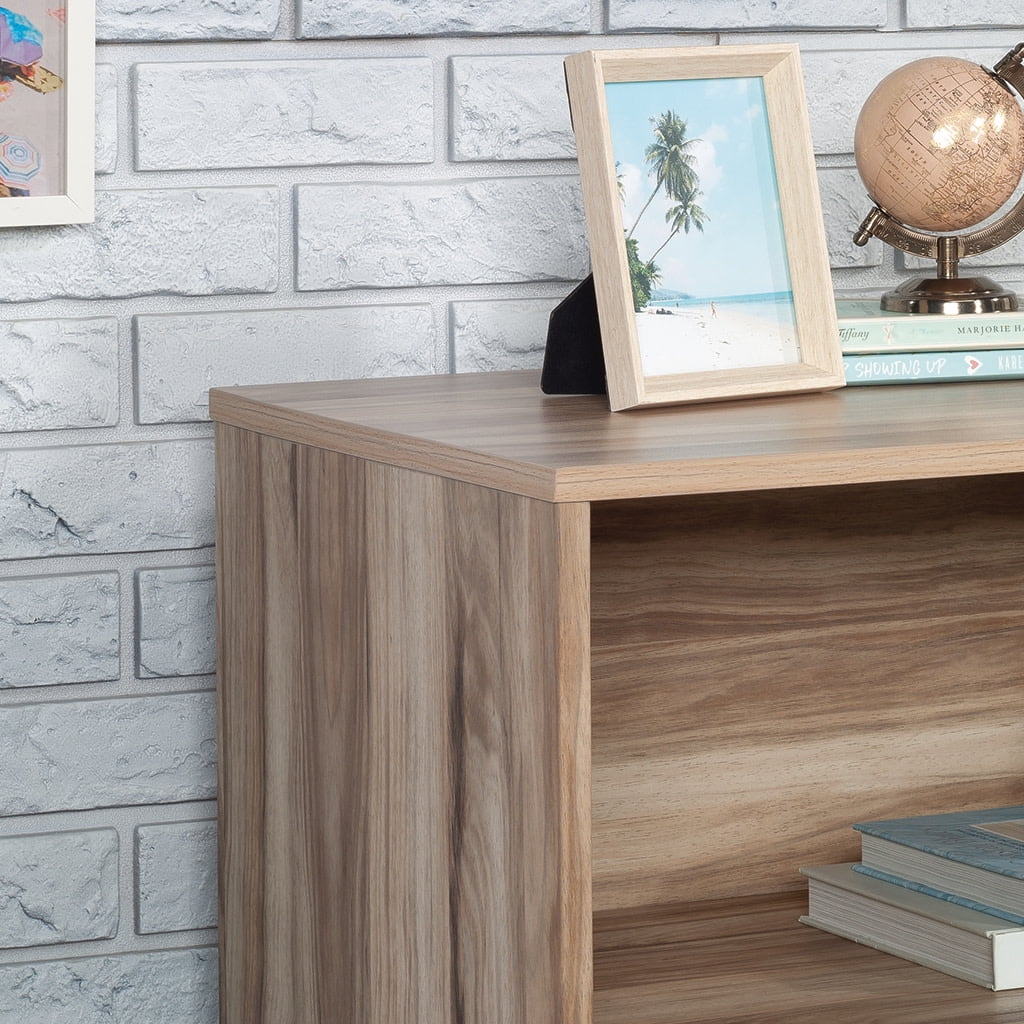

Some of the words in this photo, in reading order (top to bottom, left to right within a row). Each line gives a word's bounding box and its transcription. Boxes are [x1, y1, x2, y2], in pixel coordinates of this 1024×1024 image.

[838, 328, 869, 342] Tiffany
[957, 325, 1011, 336] MARJORIE
[855, 360, 920, 378] SHOWING
[926, 358, 946, 374] UP
